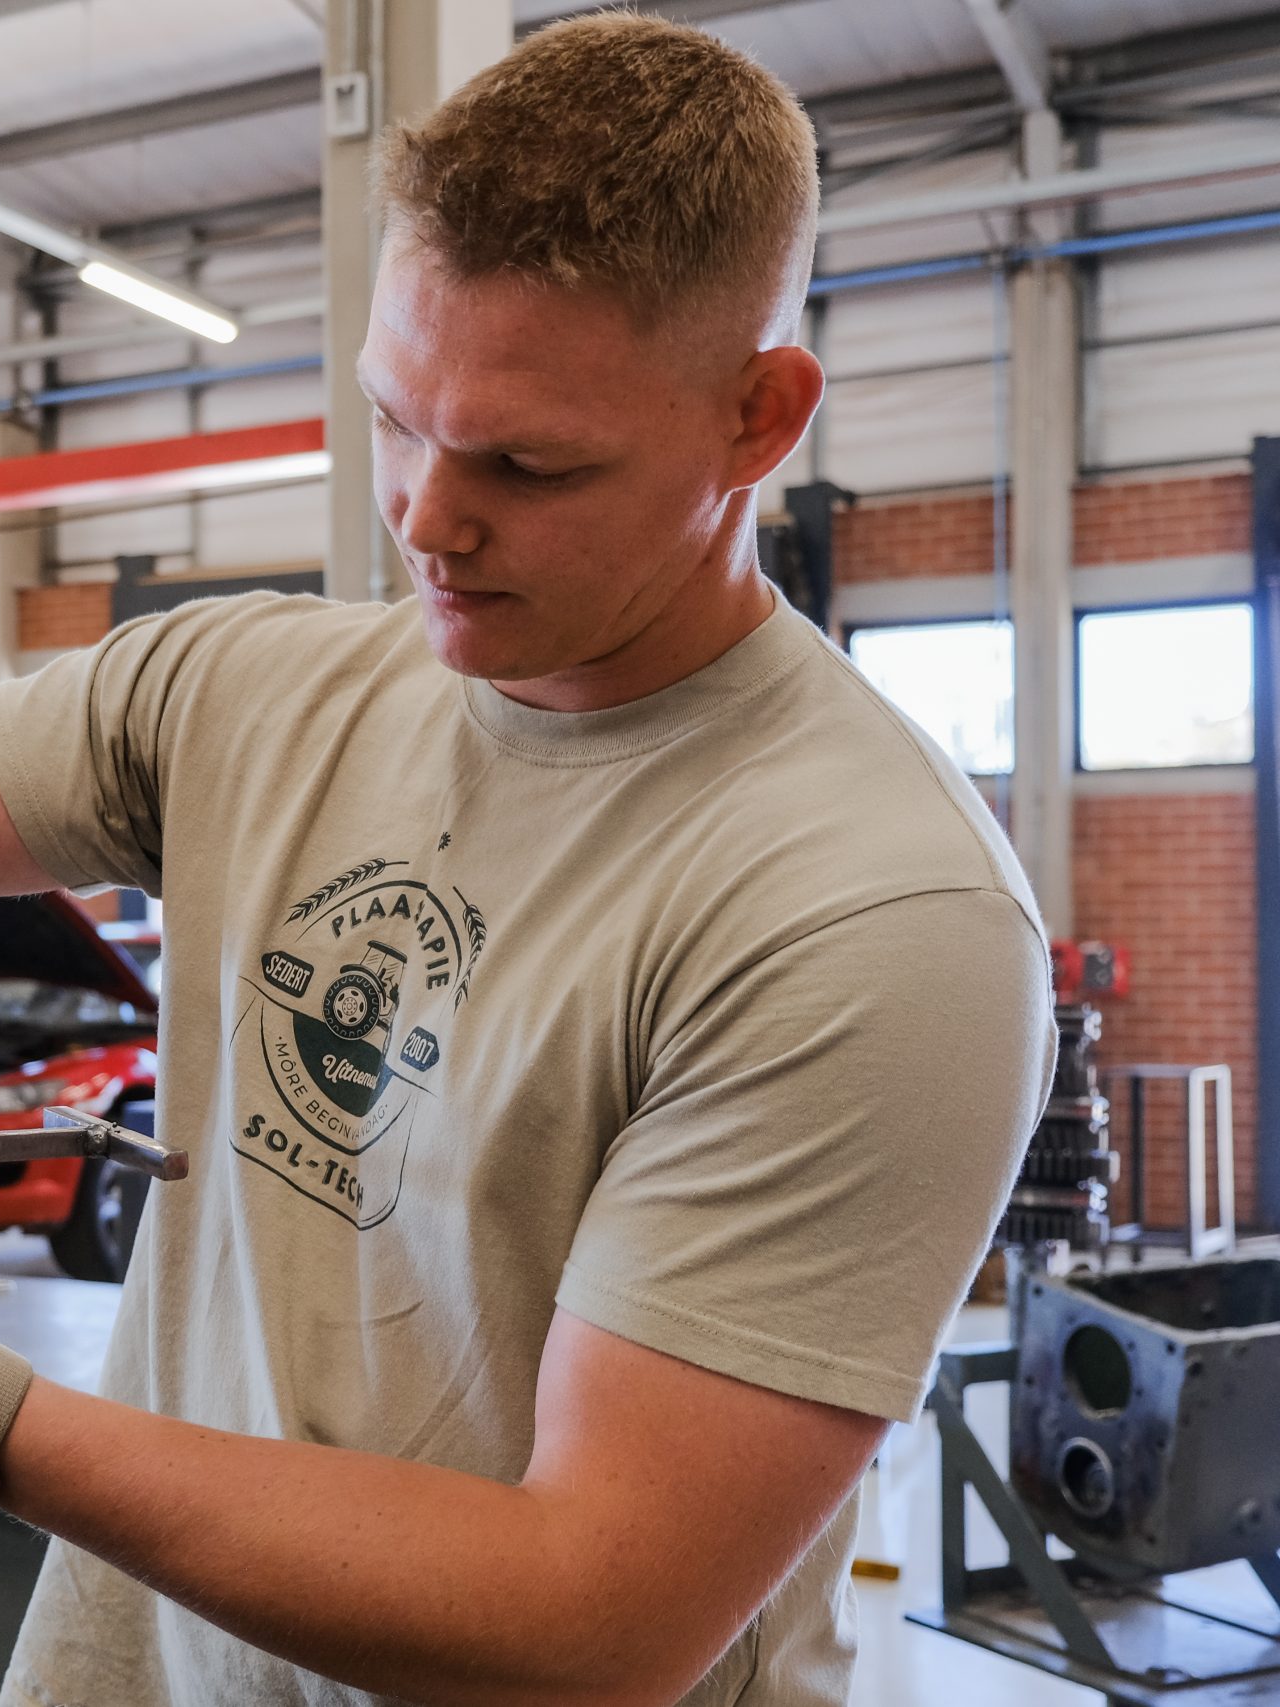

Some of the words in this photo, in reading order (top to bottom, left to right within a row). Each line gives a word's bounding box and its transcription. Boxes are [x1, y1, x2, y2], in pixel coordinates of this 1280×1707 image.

[265, 954, 311, 992] SEDERT
[403, 1032, 435, 1064] 2007
[275, 1043, 308, 1098] MÔRE
[306, 1099, 352, 1139] BEGIN
[242, 1114, 364, 1210] SOL-TECH
